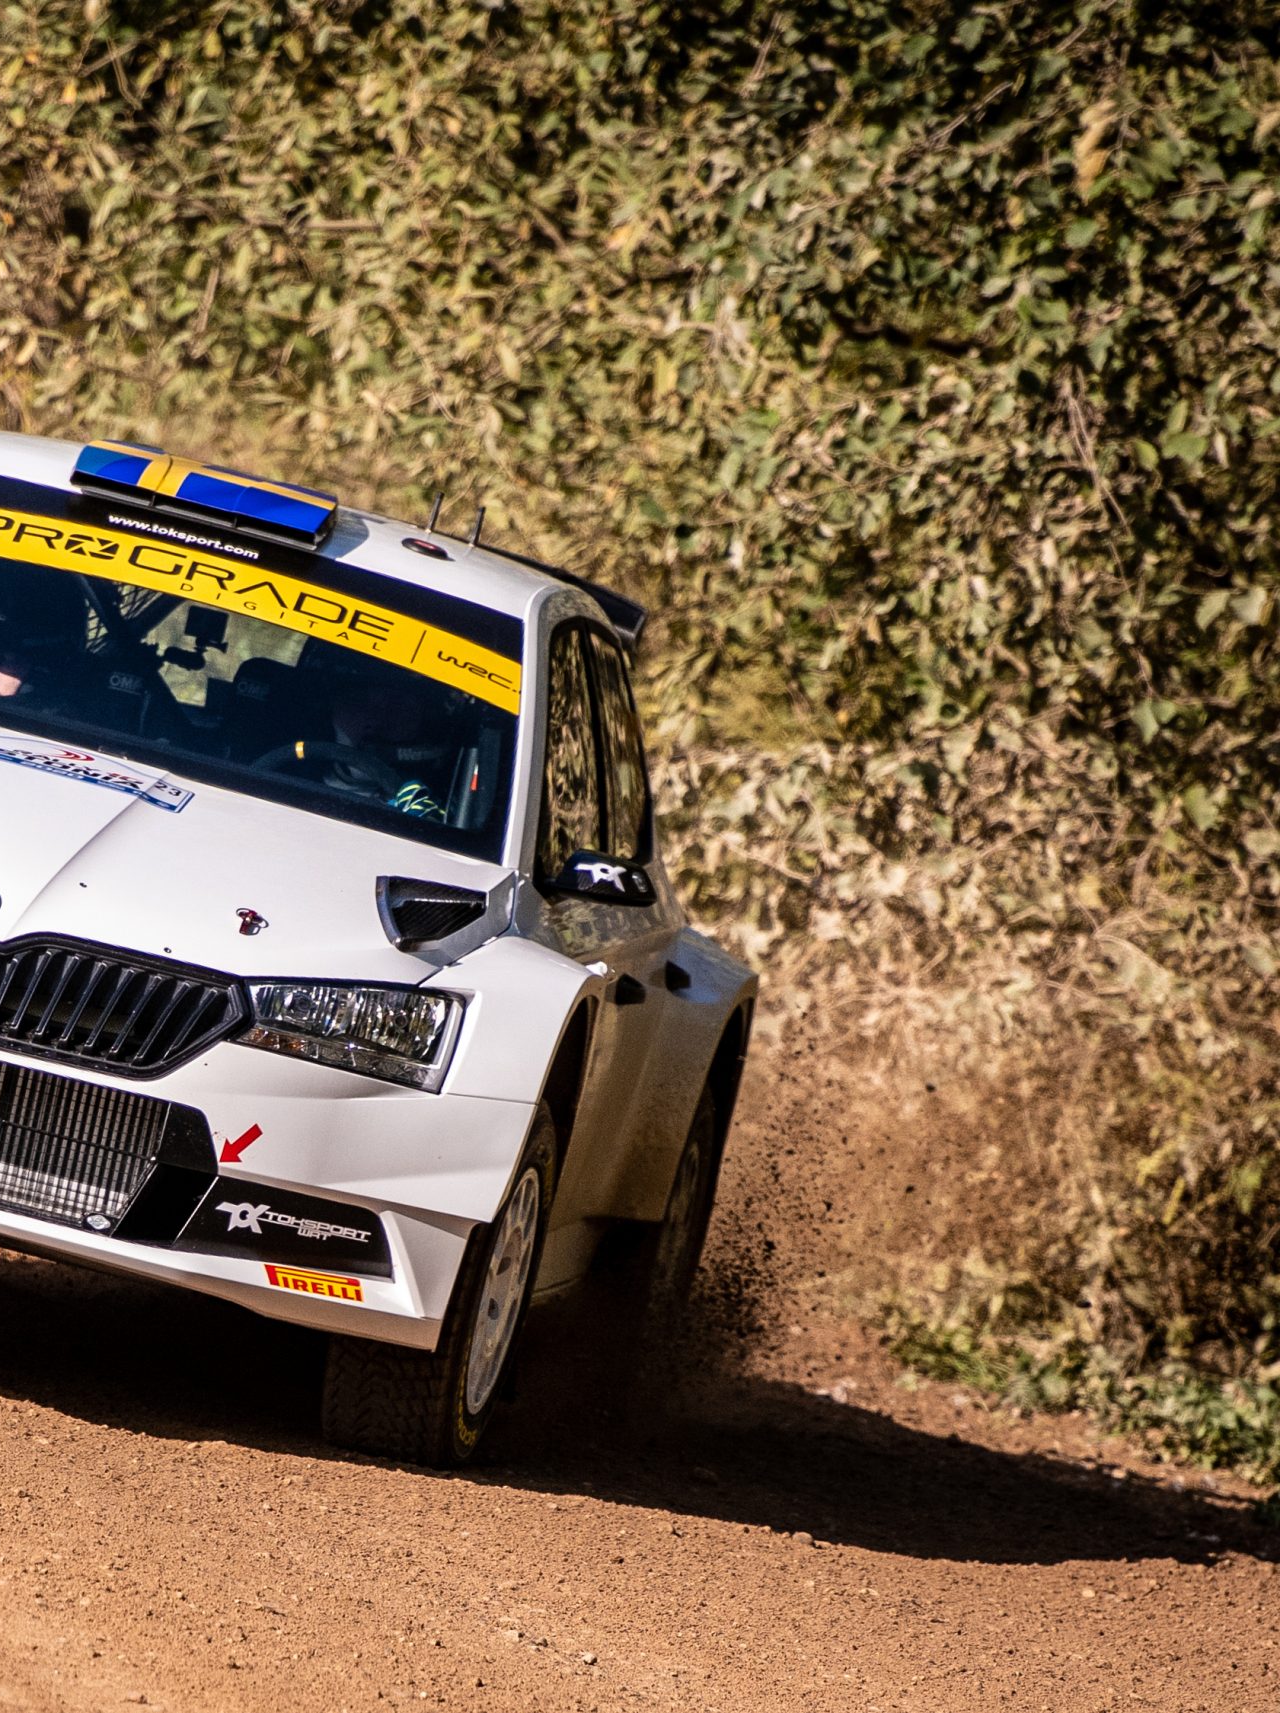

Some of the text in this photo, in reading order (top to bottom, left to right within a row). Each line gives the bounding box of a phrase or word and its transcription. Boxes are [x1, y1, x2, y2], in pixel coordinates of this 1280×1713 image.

[108, 512, 260, 561] www.toksport.com
[179, 582, 382, 652] DIGITAL
[153, 781, 183, 798] 23
[264, 1211, 372, 1242] TOKSPORT
[263, 1263, 364, 1302] PIRELLI
